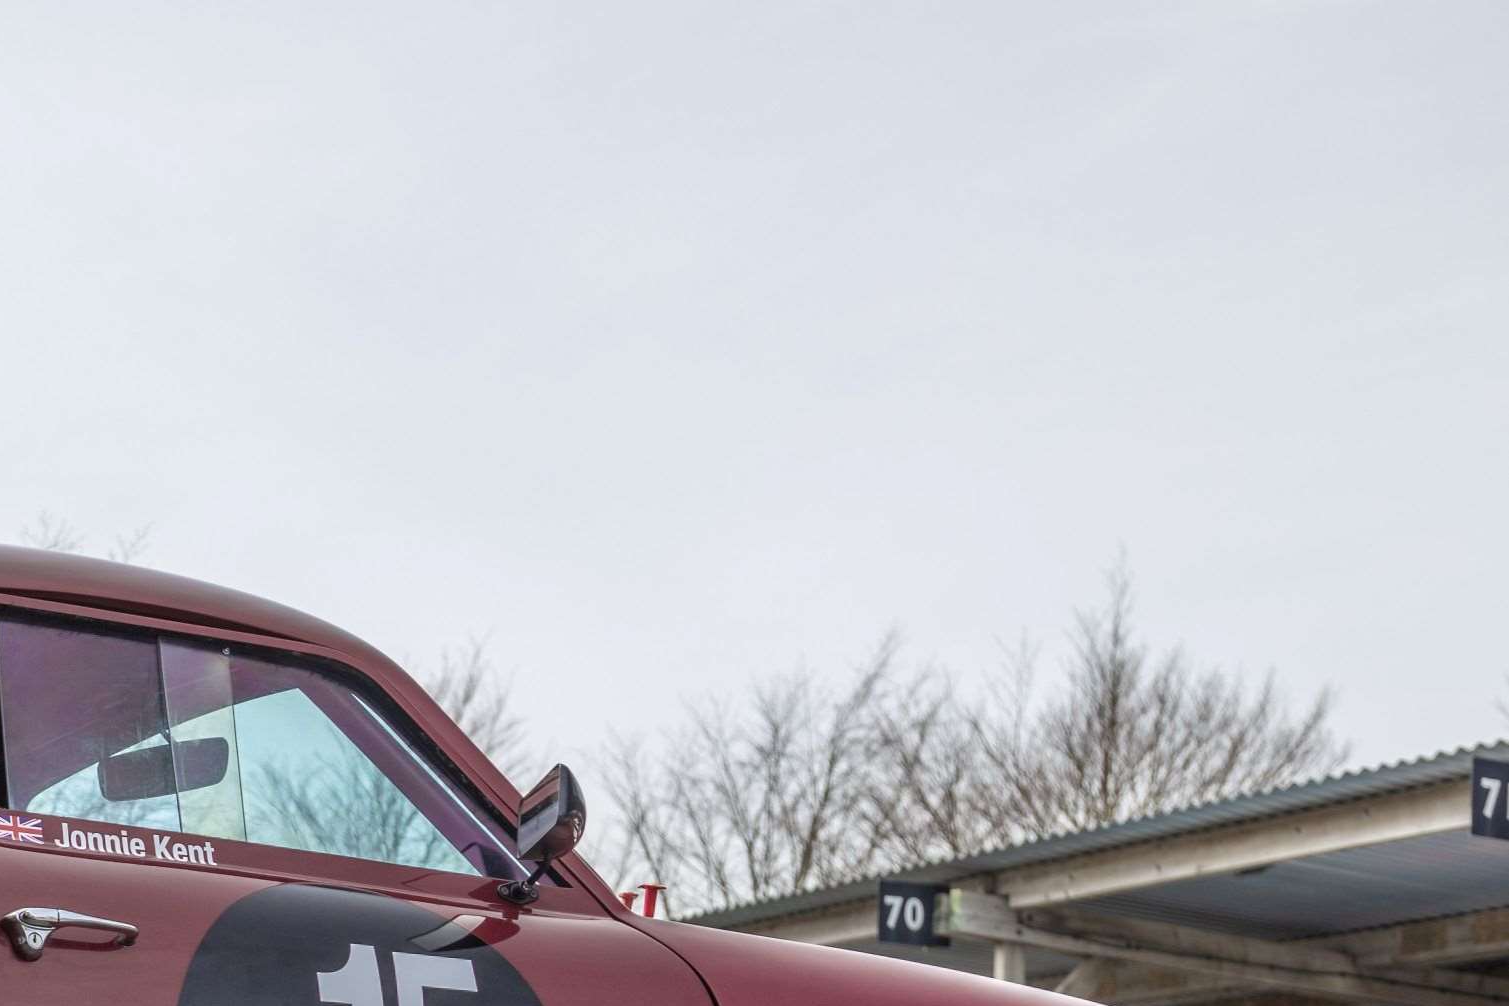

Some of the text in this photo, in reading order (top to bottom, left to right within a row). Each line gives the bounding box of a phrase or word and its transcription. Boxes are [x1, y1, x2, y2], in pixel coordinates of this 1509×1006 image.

[1480, 776, 1509, 820] 7
[54, 822, 217, 866] Jonnie Kent
[883, 894, 925, 931] 70
